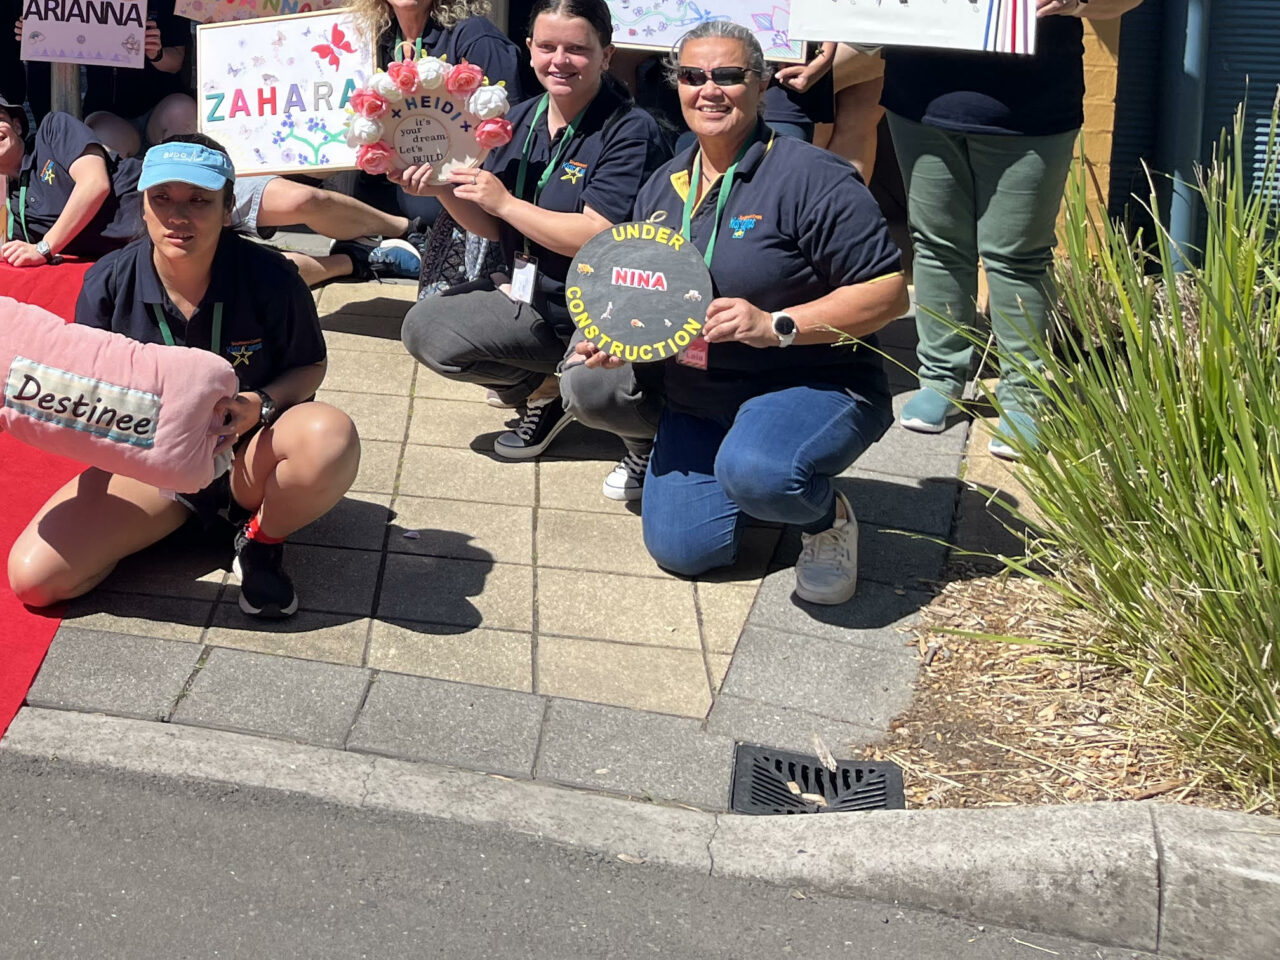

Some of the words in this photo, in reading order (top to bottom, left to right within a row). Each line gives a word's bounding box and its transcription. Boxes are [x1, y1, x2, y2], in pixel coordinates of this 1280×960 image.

[205, 78, 357, 122] ZAHARA
[405, 95, 462, 121] HEIDI
[400, 127, 422, 136] your
[399, 145, 423, 154] Let's
[612, 223, 685, 251] UNDER
[611, 267, 668, 291] NINA
[567, 286, 702, 360] CONSTRUCTION
[13, 373, 152, 435] Destinee
